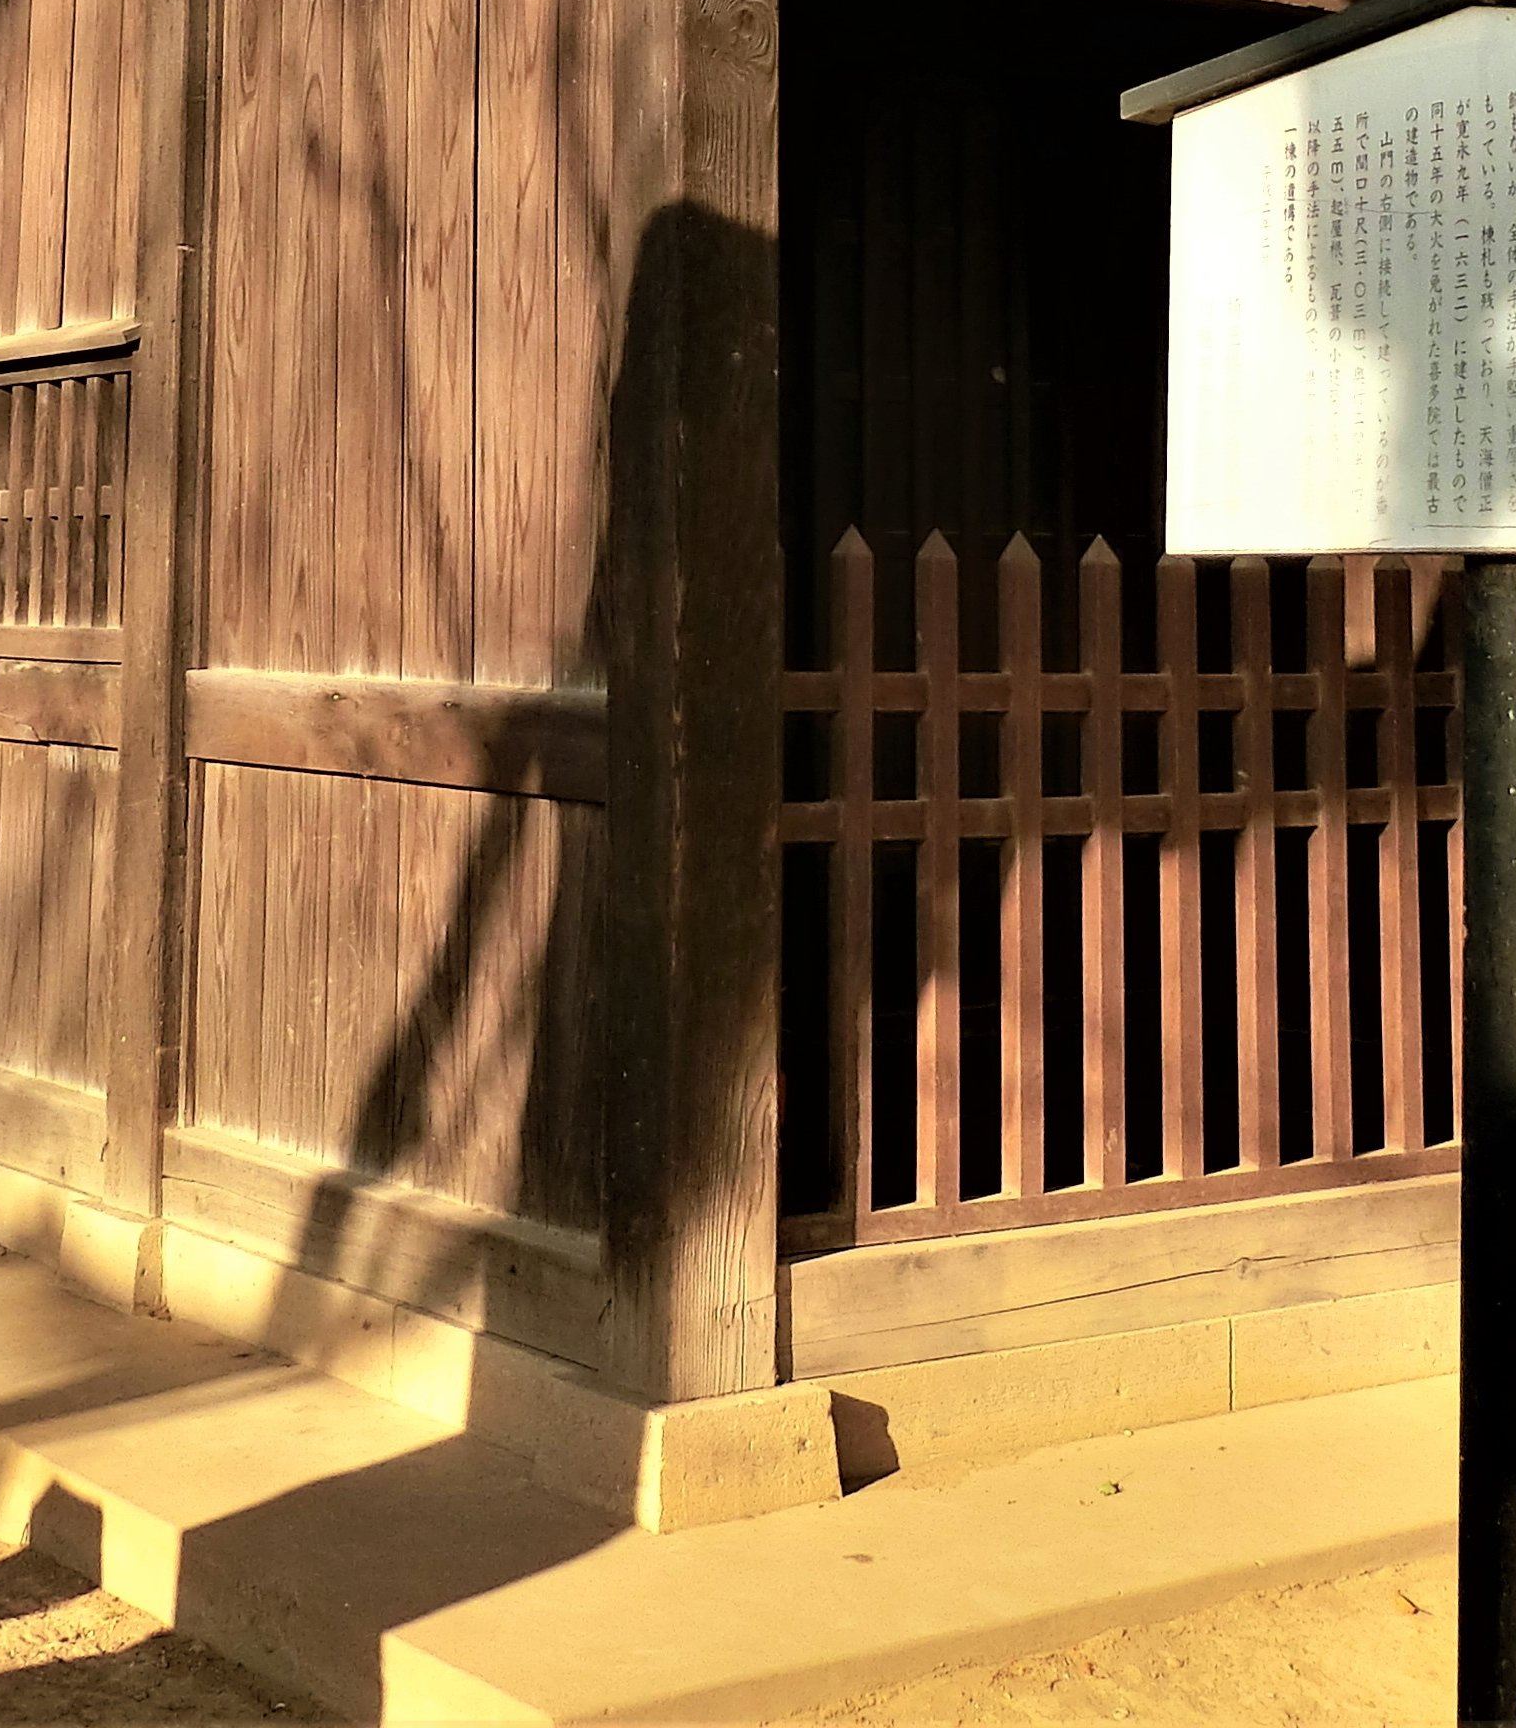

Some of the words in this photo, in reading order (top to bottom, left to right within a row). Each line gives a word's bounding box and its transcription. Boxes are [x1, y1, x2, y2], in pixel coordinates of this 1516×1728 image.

[1404, 106, 1419, 261] の建造物である。
